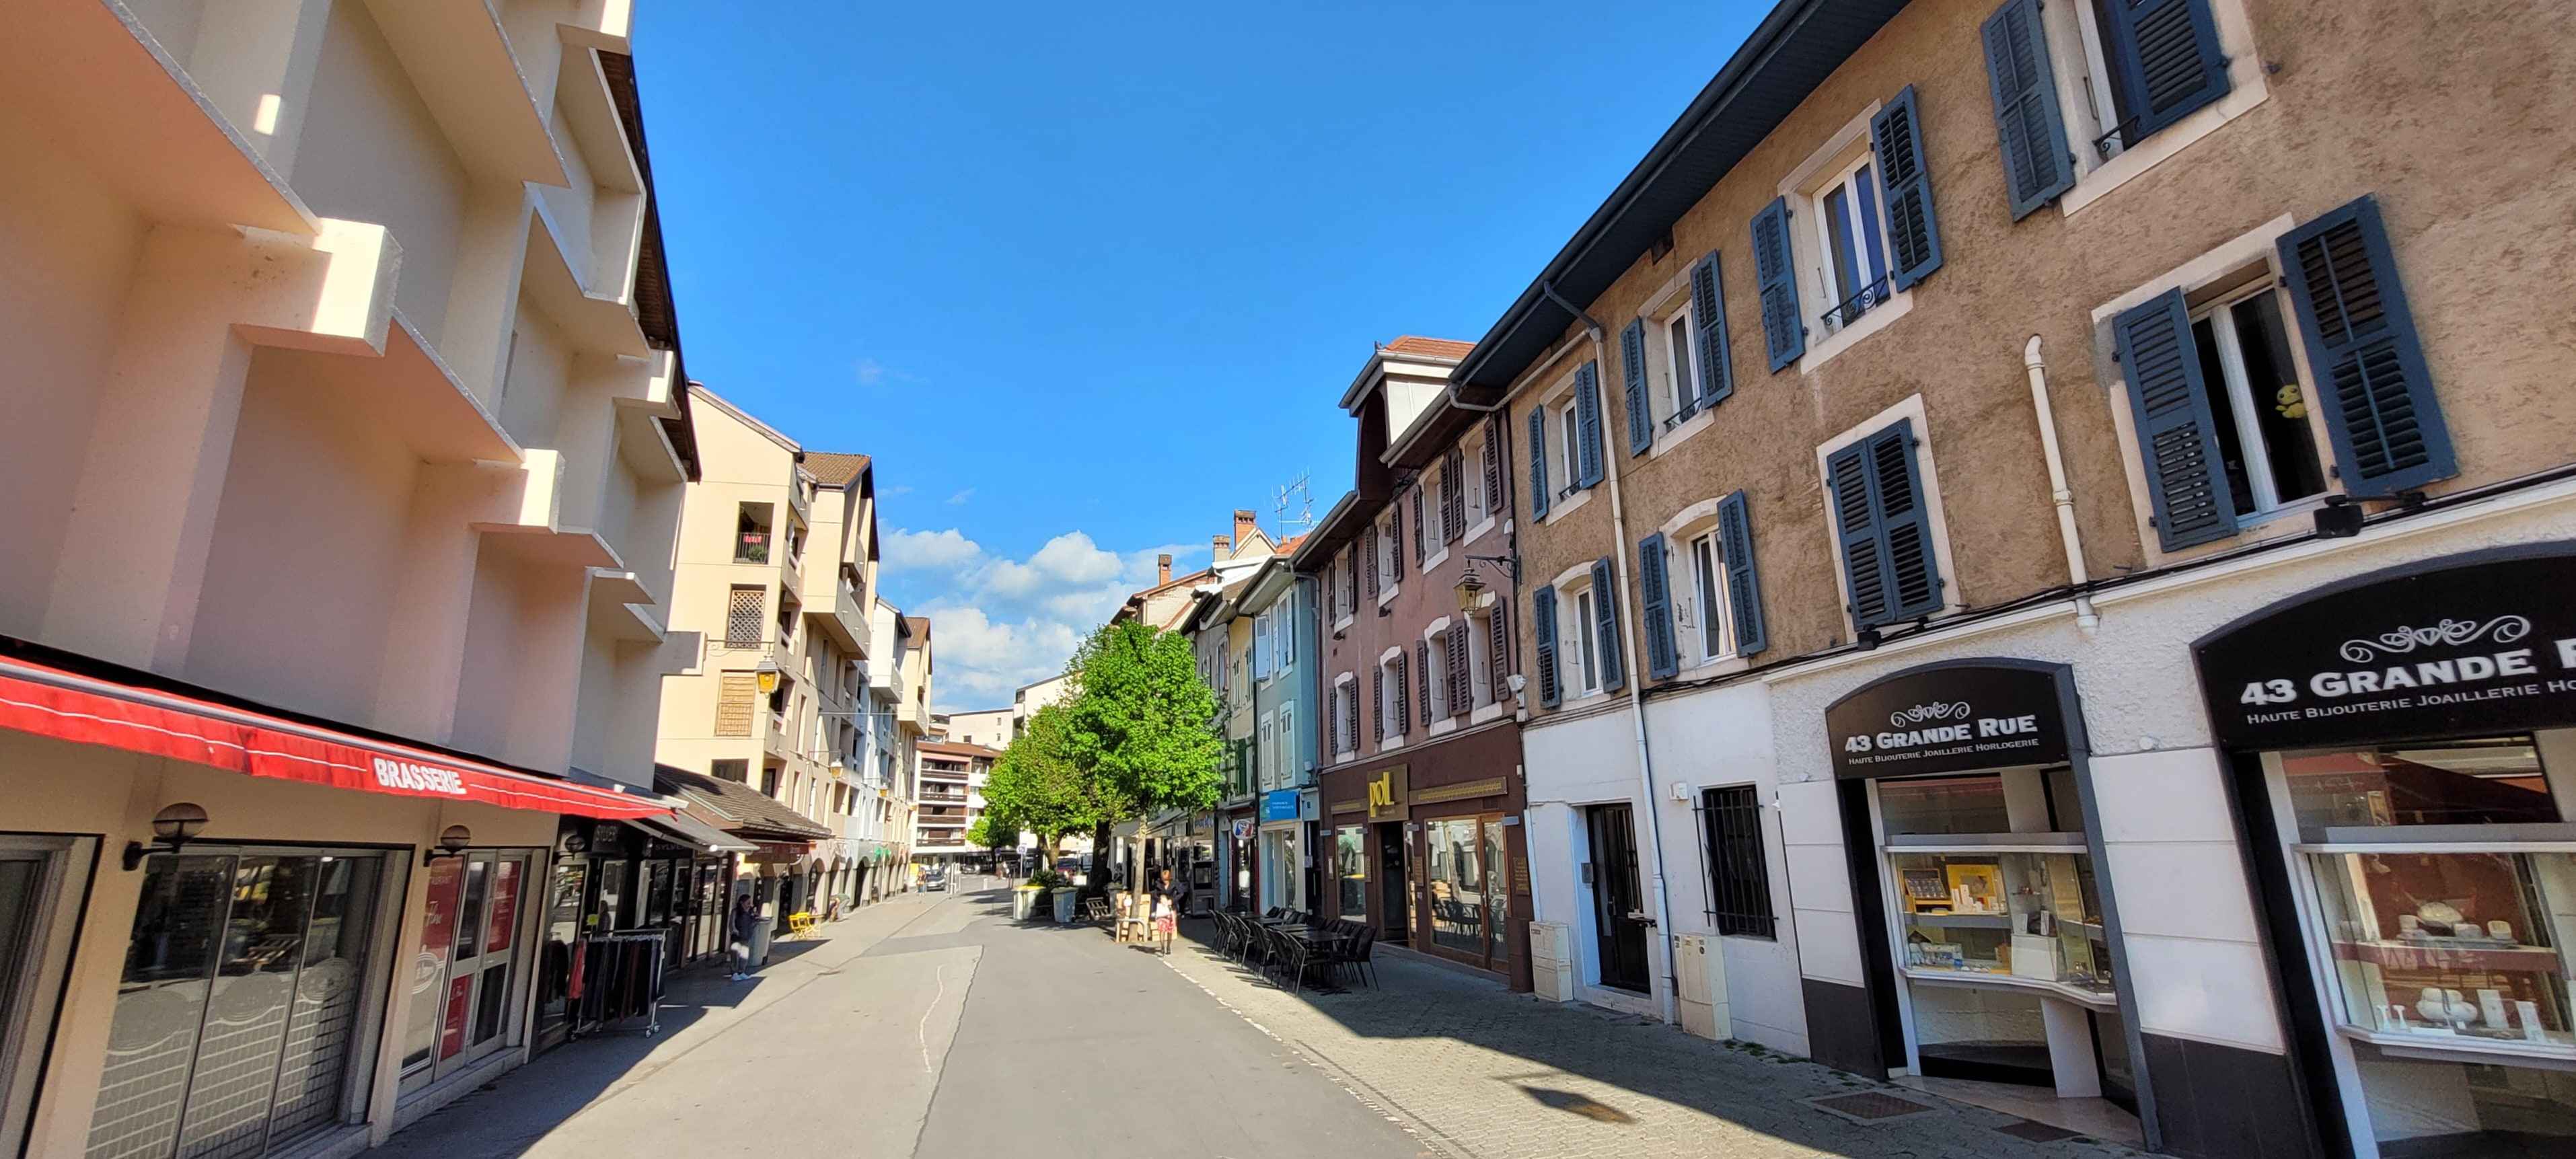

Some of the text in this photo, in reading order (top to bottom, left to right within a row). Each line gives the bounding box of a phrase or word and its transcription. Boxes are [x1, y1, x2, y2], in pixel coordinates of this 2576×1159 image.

[2240, 678, 2297, 706] 43
[2310, 648, 2538, 698] GRANDE
[2247, 710, 2301, 724] HAUTE
[2306, 698, 2413, 718] BIJOUTERIE
[2417, 683, 2540, 707] JOAILLERIE
[1844, 714, 2038, 753] 43 GRANDE RUE
[1849, 739, 2039, 765] HAUTE BIJOUTERIE JOAILLERIE HORLOGERIE
[373, 757, 468, 794] BRASSERIE
